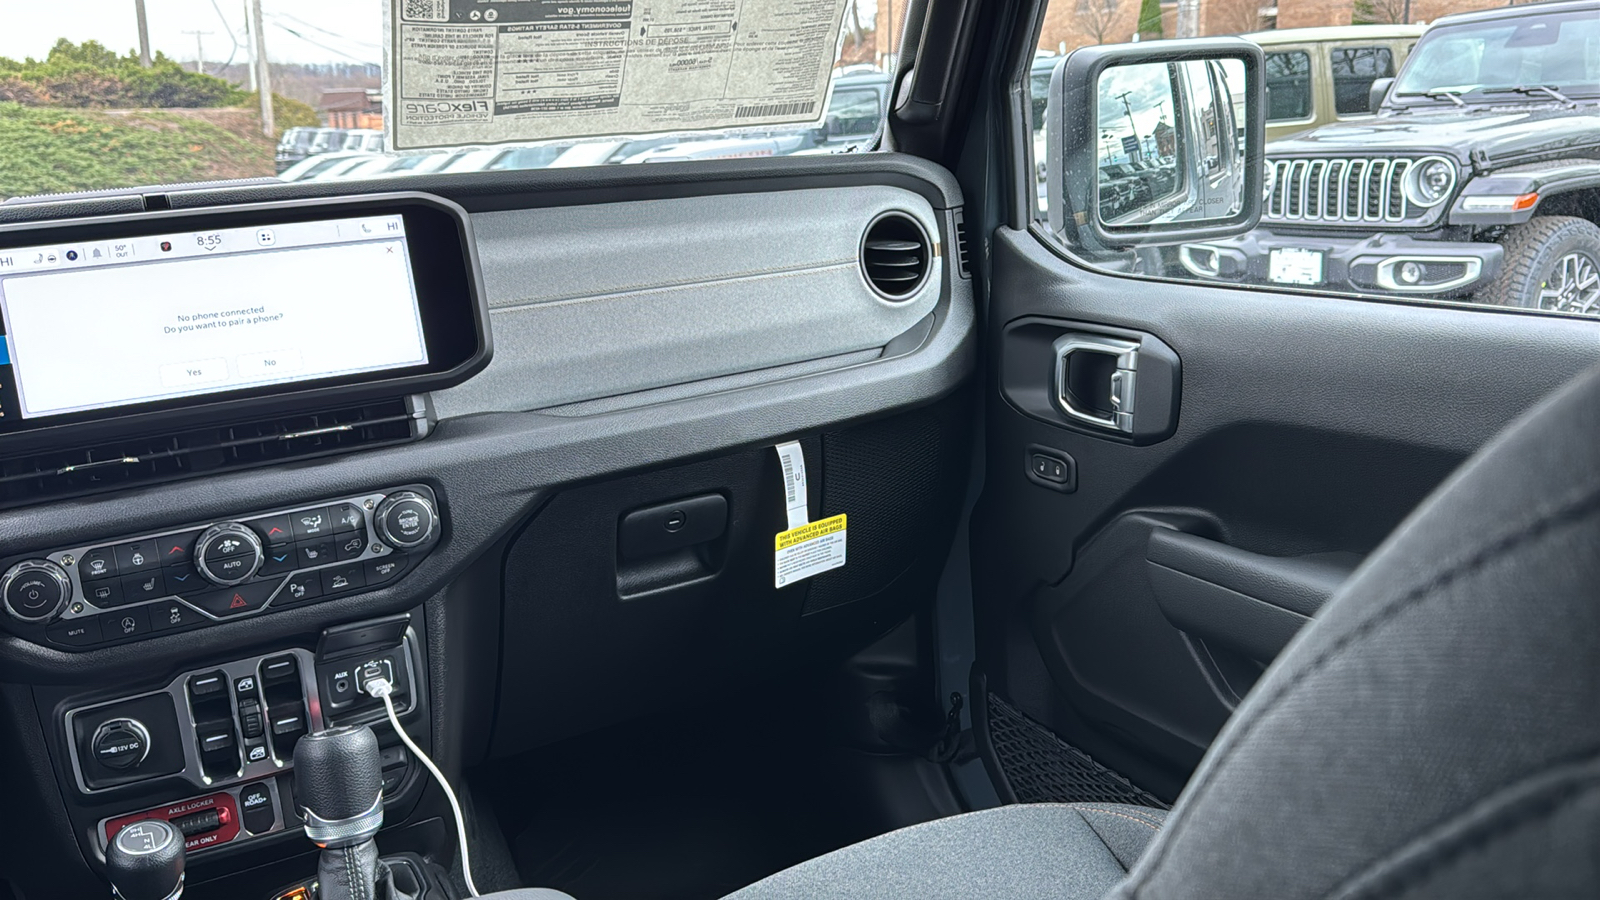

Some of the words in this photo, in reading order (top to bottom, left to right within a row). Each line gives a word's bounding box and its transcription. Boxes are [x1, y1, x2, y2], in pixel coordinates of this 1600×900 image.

[387, 222, 398, 231] HI
[197, 235, 221, 246] 8:55
[1, 257, 13, 267] HI
[192, 312, 219, 321] phone
[220, 306, 264, 317] connected
[178, 324, 194, 333] you
[196, 321, 217, 330] want
[229, 318, 244, 327] pair
[253, 313, 283, 324] phone?
[341, 516, 356, 524] A/C
[791, 527, 811, 537] VEHICLE
[818, 518, 842, 529] EQUIPPED
[793, 531, 819, 543] ADVANCED
[223, 561, 241, 569] AUTO
[376, 563, 395, 571] SCREEN
[68, 628, 85, 636] MUTE
[248, 793, 261, 801] OFF
[168, 805, 186, 815] AXLE
[187, 799, 214, 811] LOCKER
[186, 839, 200, 848] EAR
[201, 835, 218, 845] ONLY
